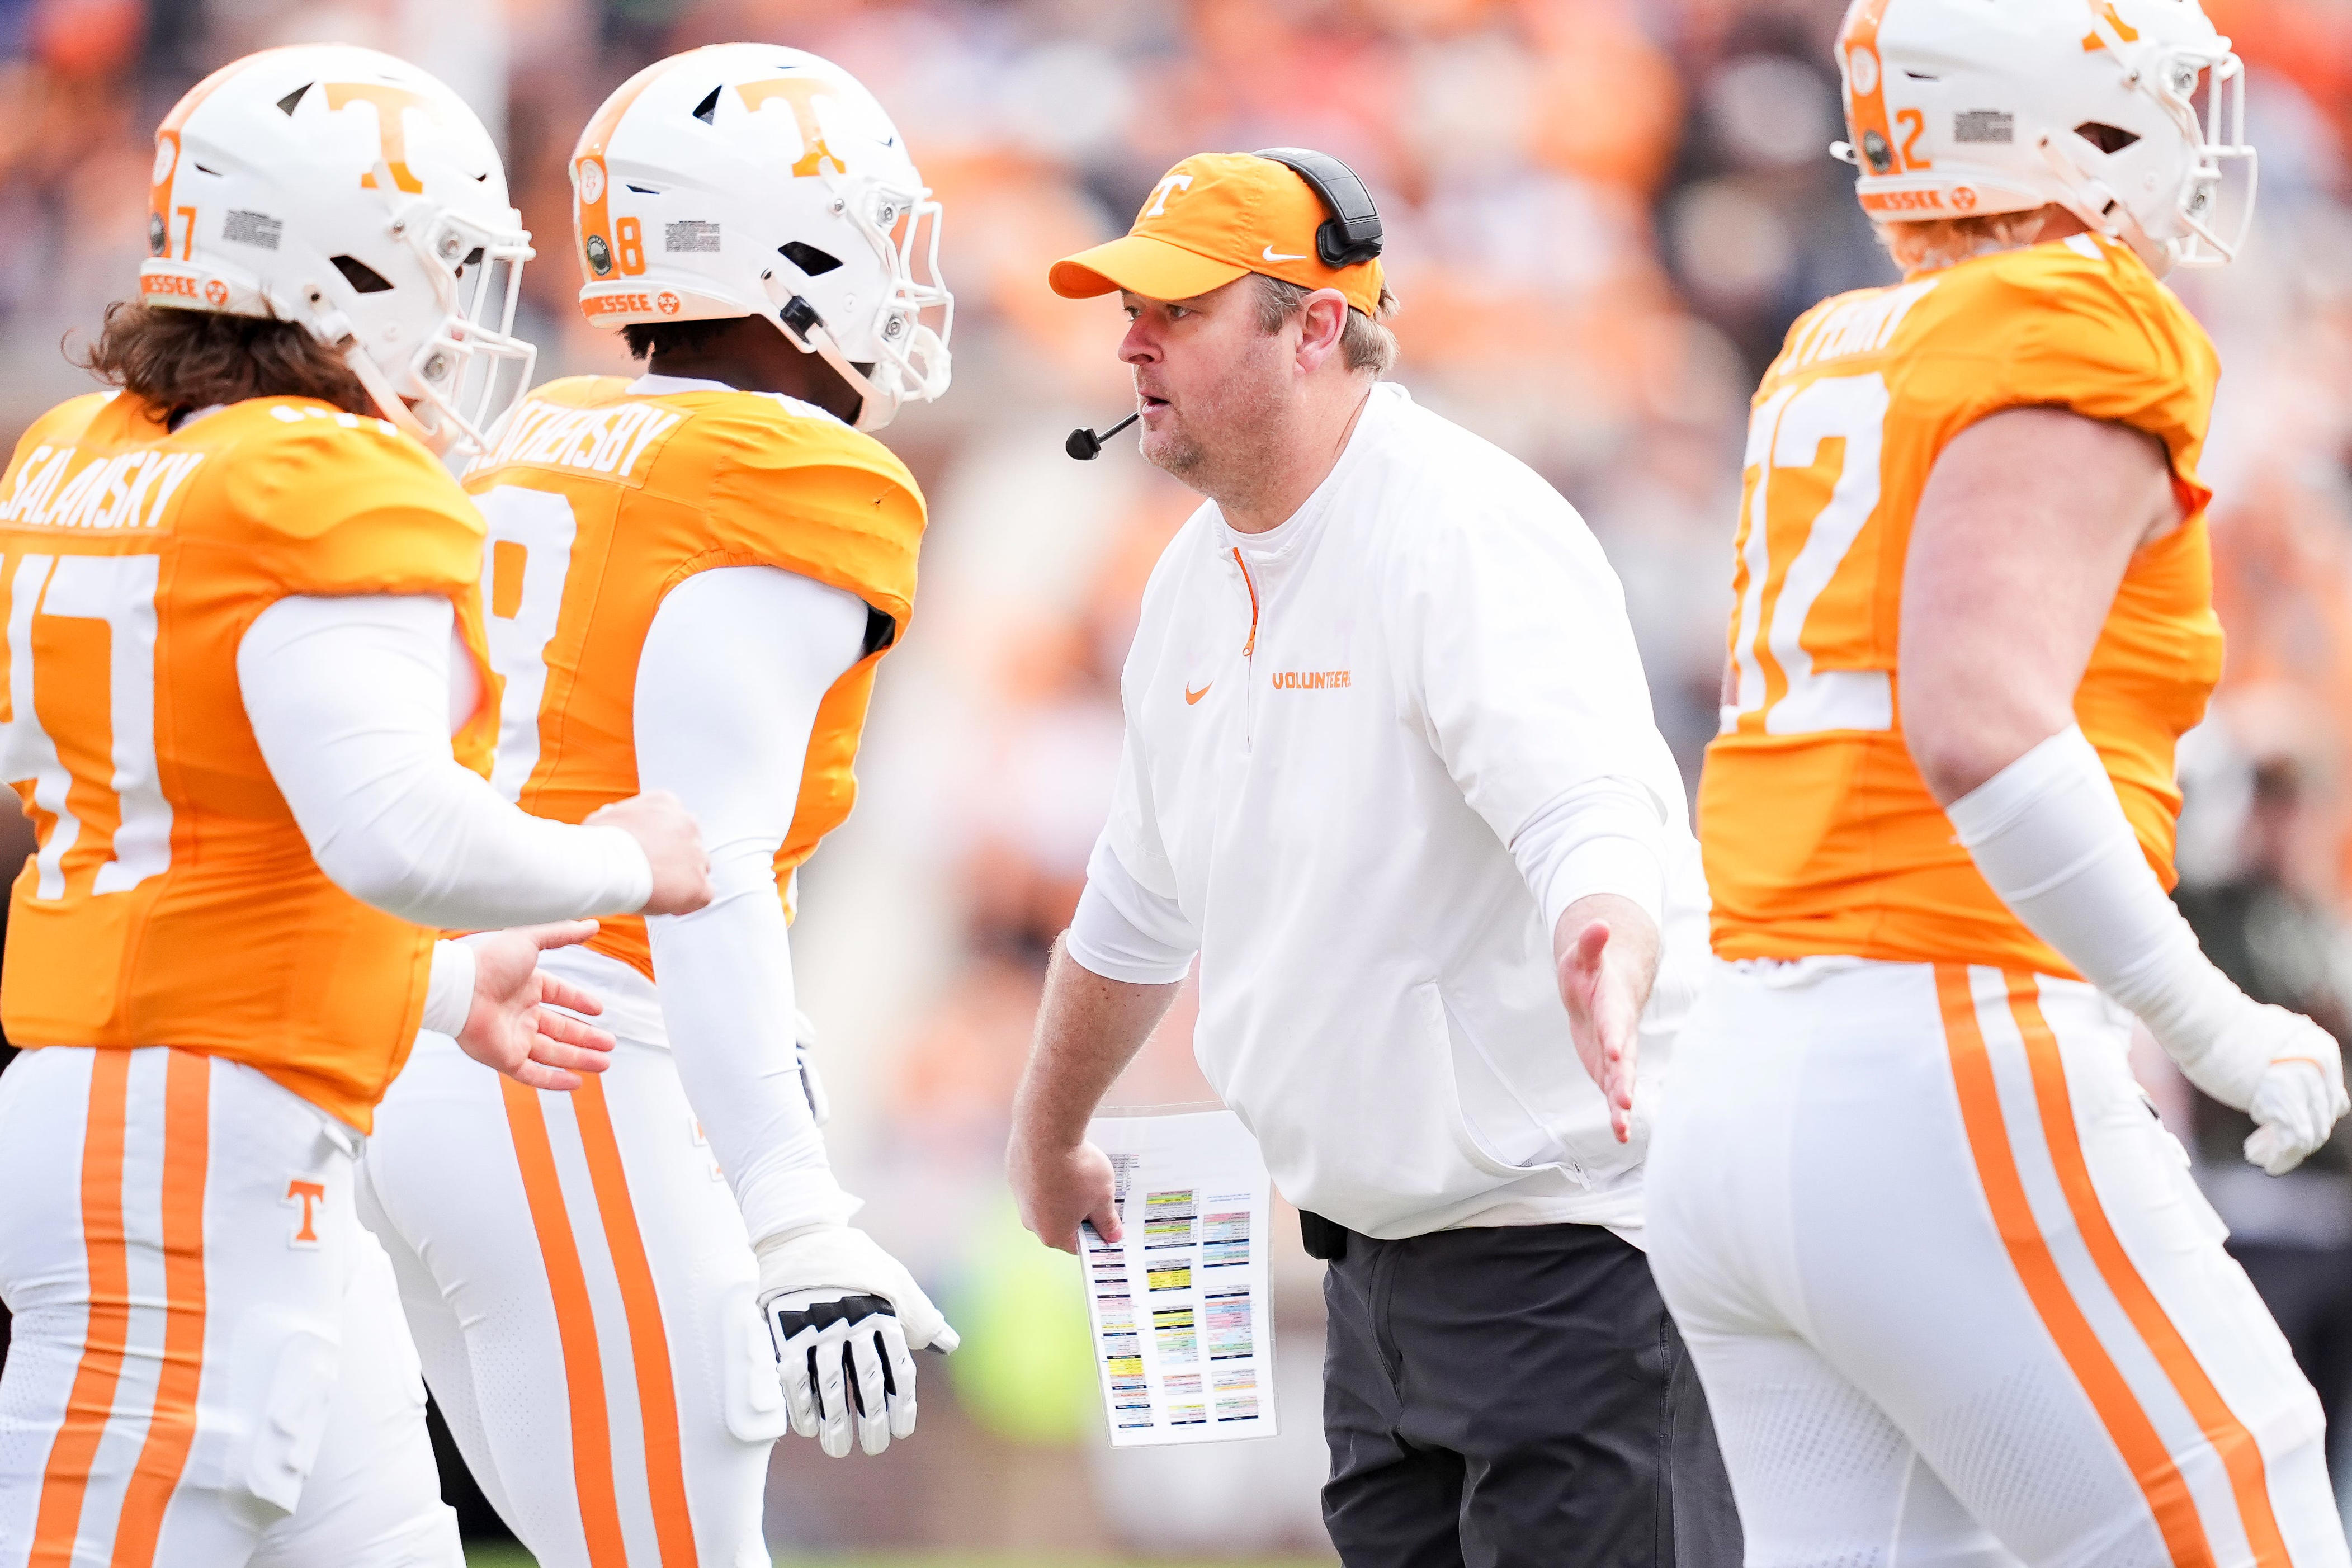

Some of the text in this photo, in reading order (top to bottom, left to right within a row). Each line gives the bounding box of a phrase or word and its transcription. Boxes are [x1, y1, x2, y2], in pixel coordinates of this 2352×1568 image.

[1896, 108, 1931, 171] 2
[1146, 174, 1194, 218] T
[177, 206, 197, 261] 7
[616, 217, 646, 276] 8
[0, 445, 205, 528] SALANSKY
[287, 1179, 324, 1241] T
